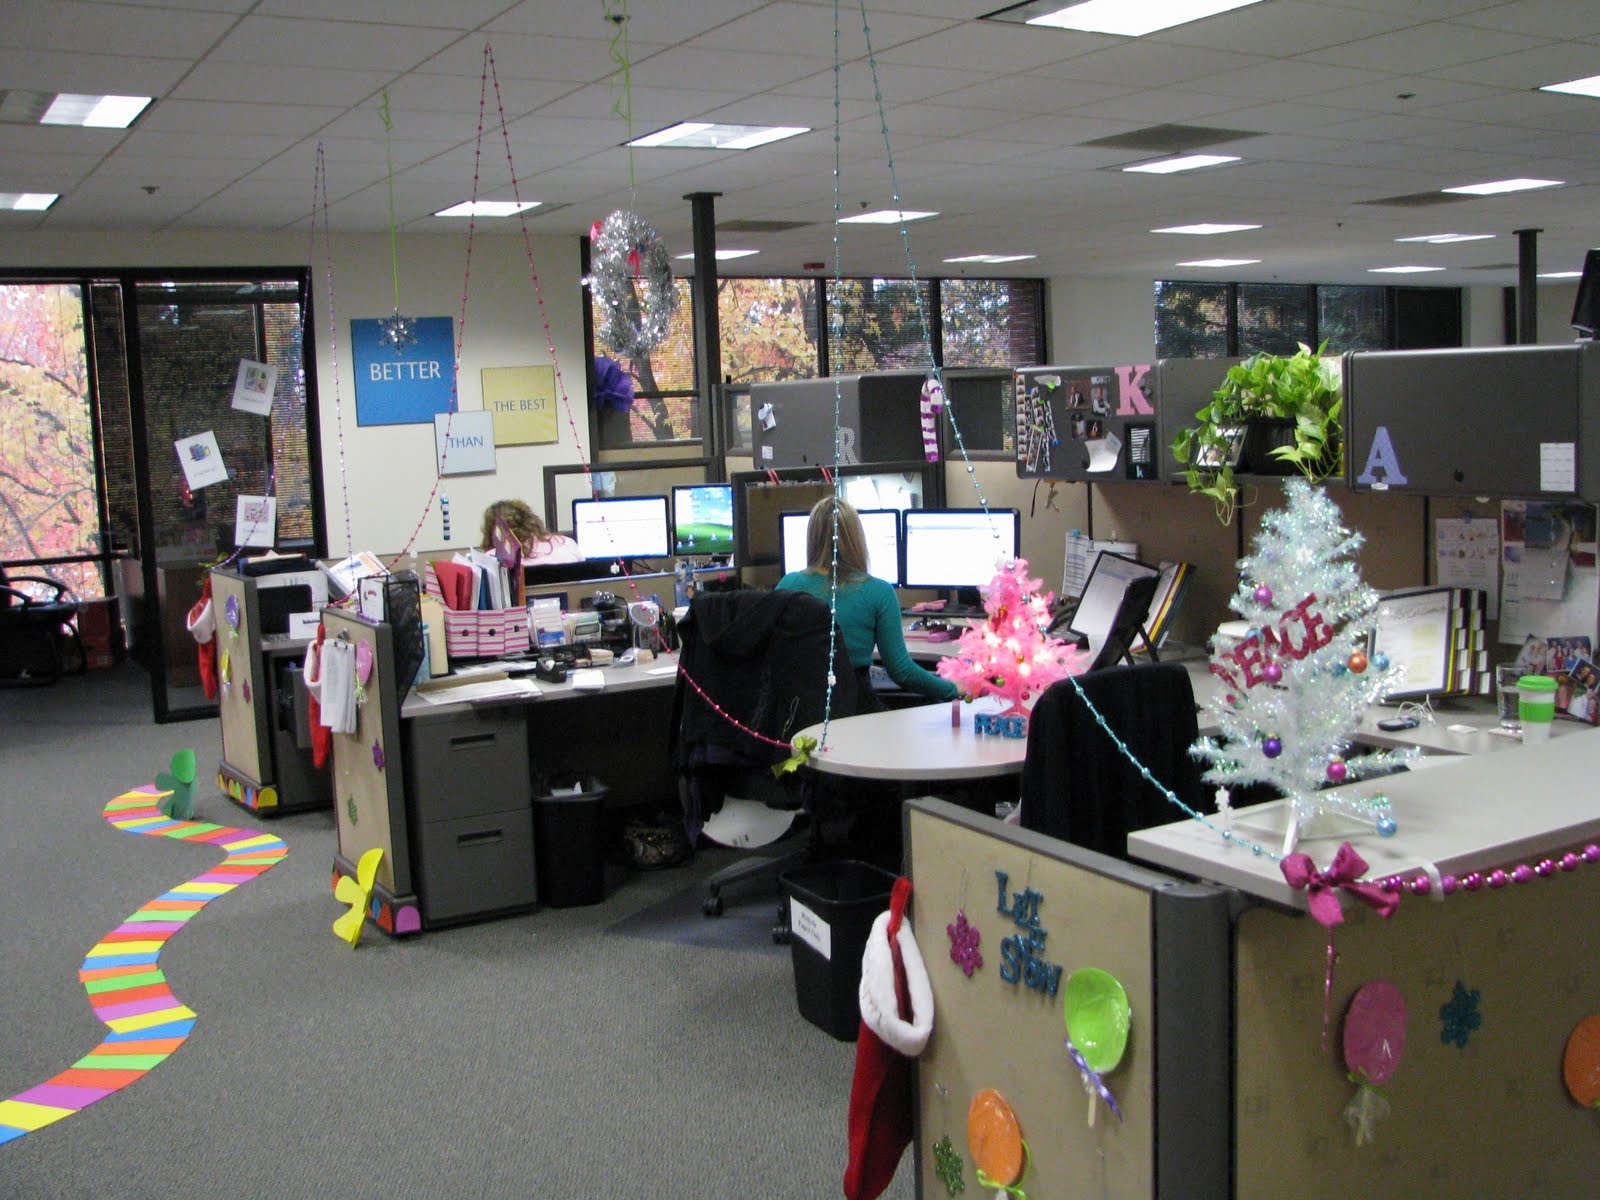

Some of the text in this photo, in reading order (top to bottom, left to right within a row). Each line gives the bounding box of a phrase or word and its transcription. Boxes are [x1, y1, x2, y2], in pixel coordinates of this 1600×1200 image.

[370, 361, 441, 382] BETTER
[493, 398, 547, 412] THE BEST
[1114, 364, 1155, 416] K
[449, 436, 484, 449] THAN
[838, 427, 860, 466] R
[1357, 426, 1408, 485] A
